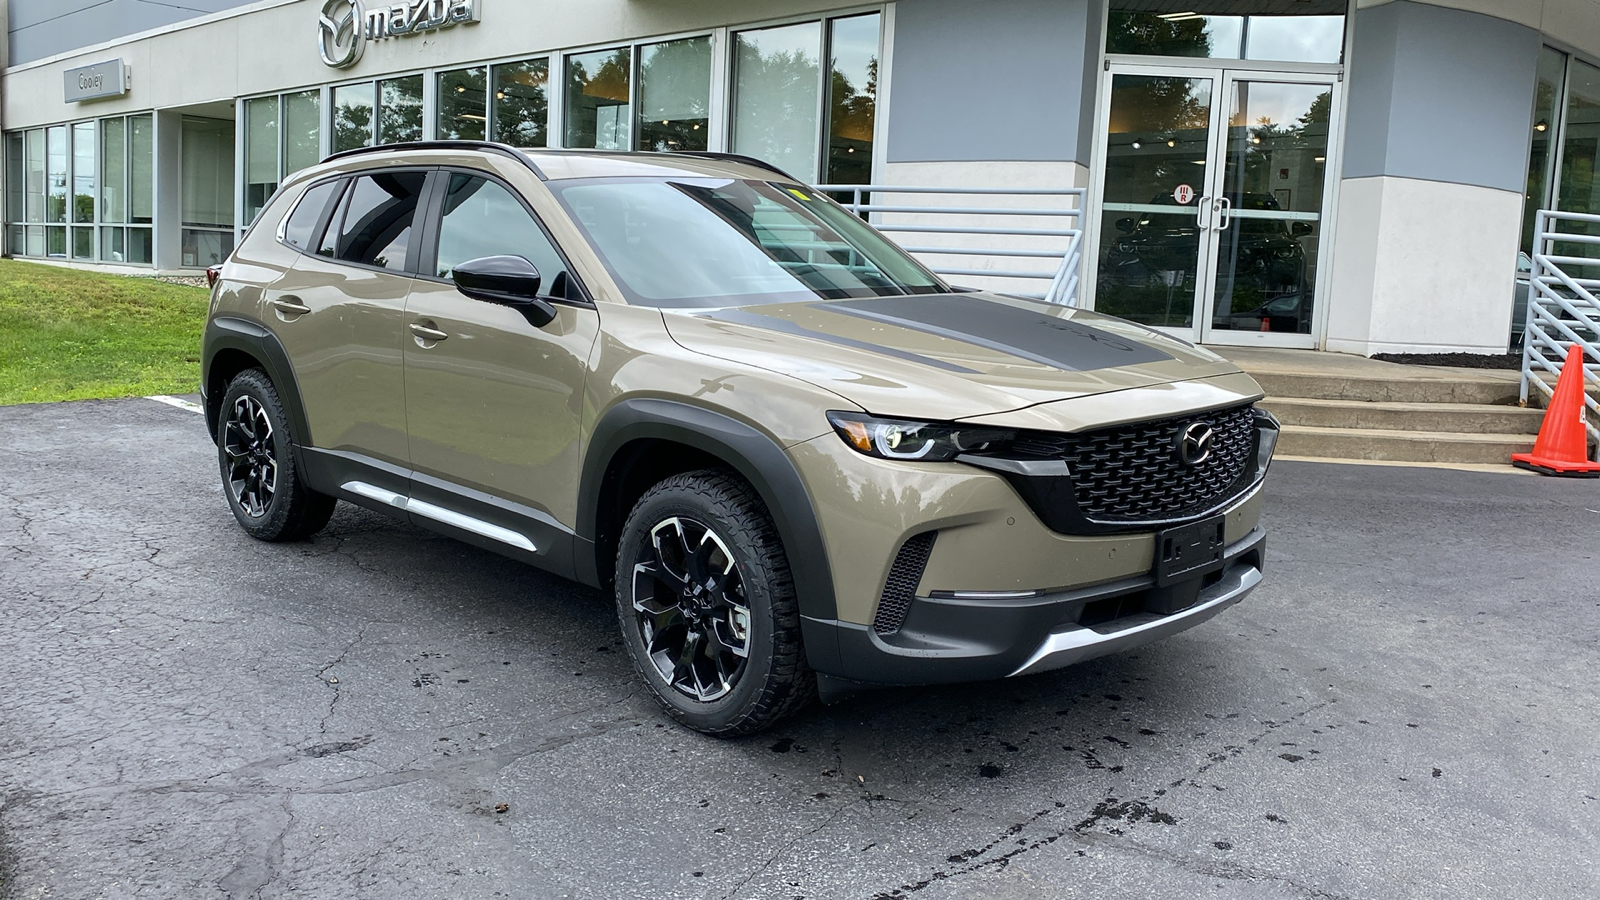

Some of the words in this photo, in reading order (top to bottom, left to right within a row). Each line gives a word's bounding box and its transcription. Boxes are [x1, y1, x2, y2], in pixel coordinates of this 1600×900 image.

[366, 0, 476, 41] mazda
[78, 69, 104, 92] Cooley
[1180, 194, 1187, 202] R
